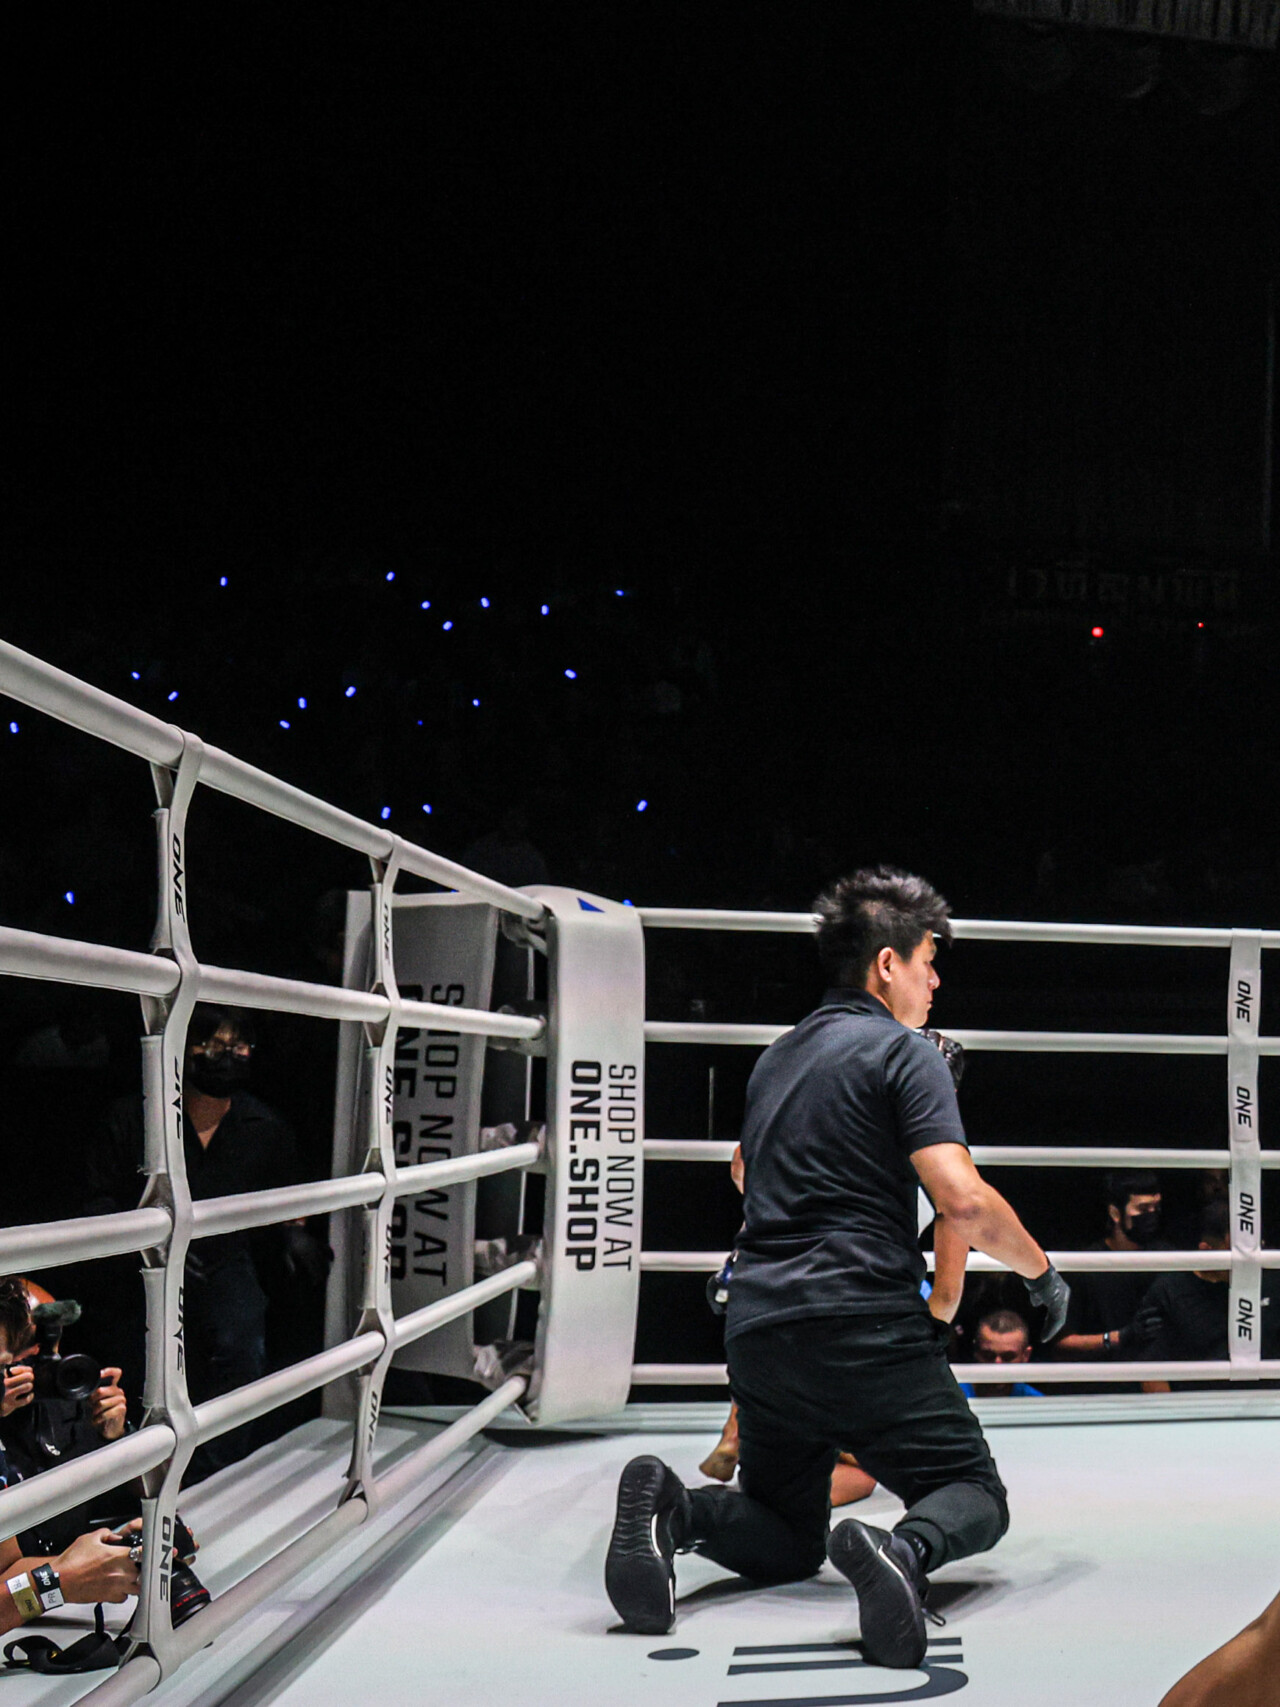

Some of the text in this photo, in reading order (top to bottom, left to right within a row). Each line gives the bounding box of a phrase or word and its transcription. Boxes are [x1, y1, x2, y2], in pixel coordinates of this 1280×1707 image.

[173, 832, 185, 924] ONE
[1233, 980, 1251, 1023] ONE
[1233, 1086, 1252, 1128] ONE
[565, 1060, 602, 1272] ONE.SHOP
[602, 1064, 637, 1272] SHOP NOW AT
[1237, 1192, 1255, 1236] ONE
[413, 1231, 448, 1286] AT
[1235, 1298, 1253, 1341] ONE
[159, 1515, 172, 1603] ONE
